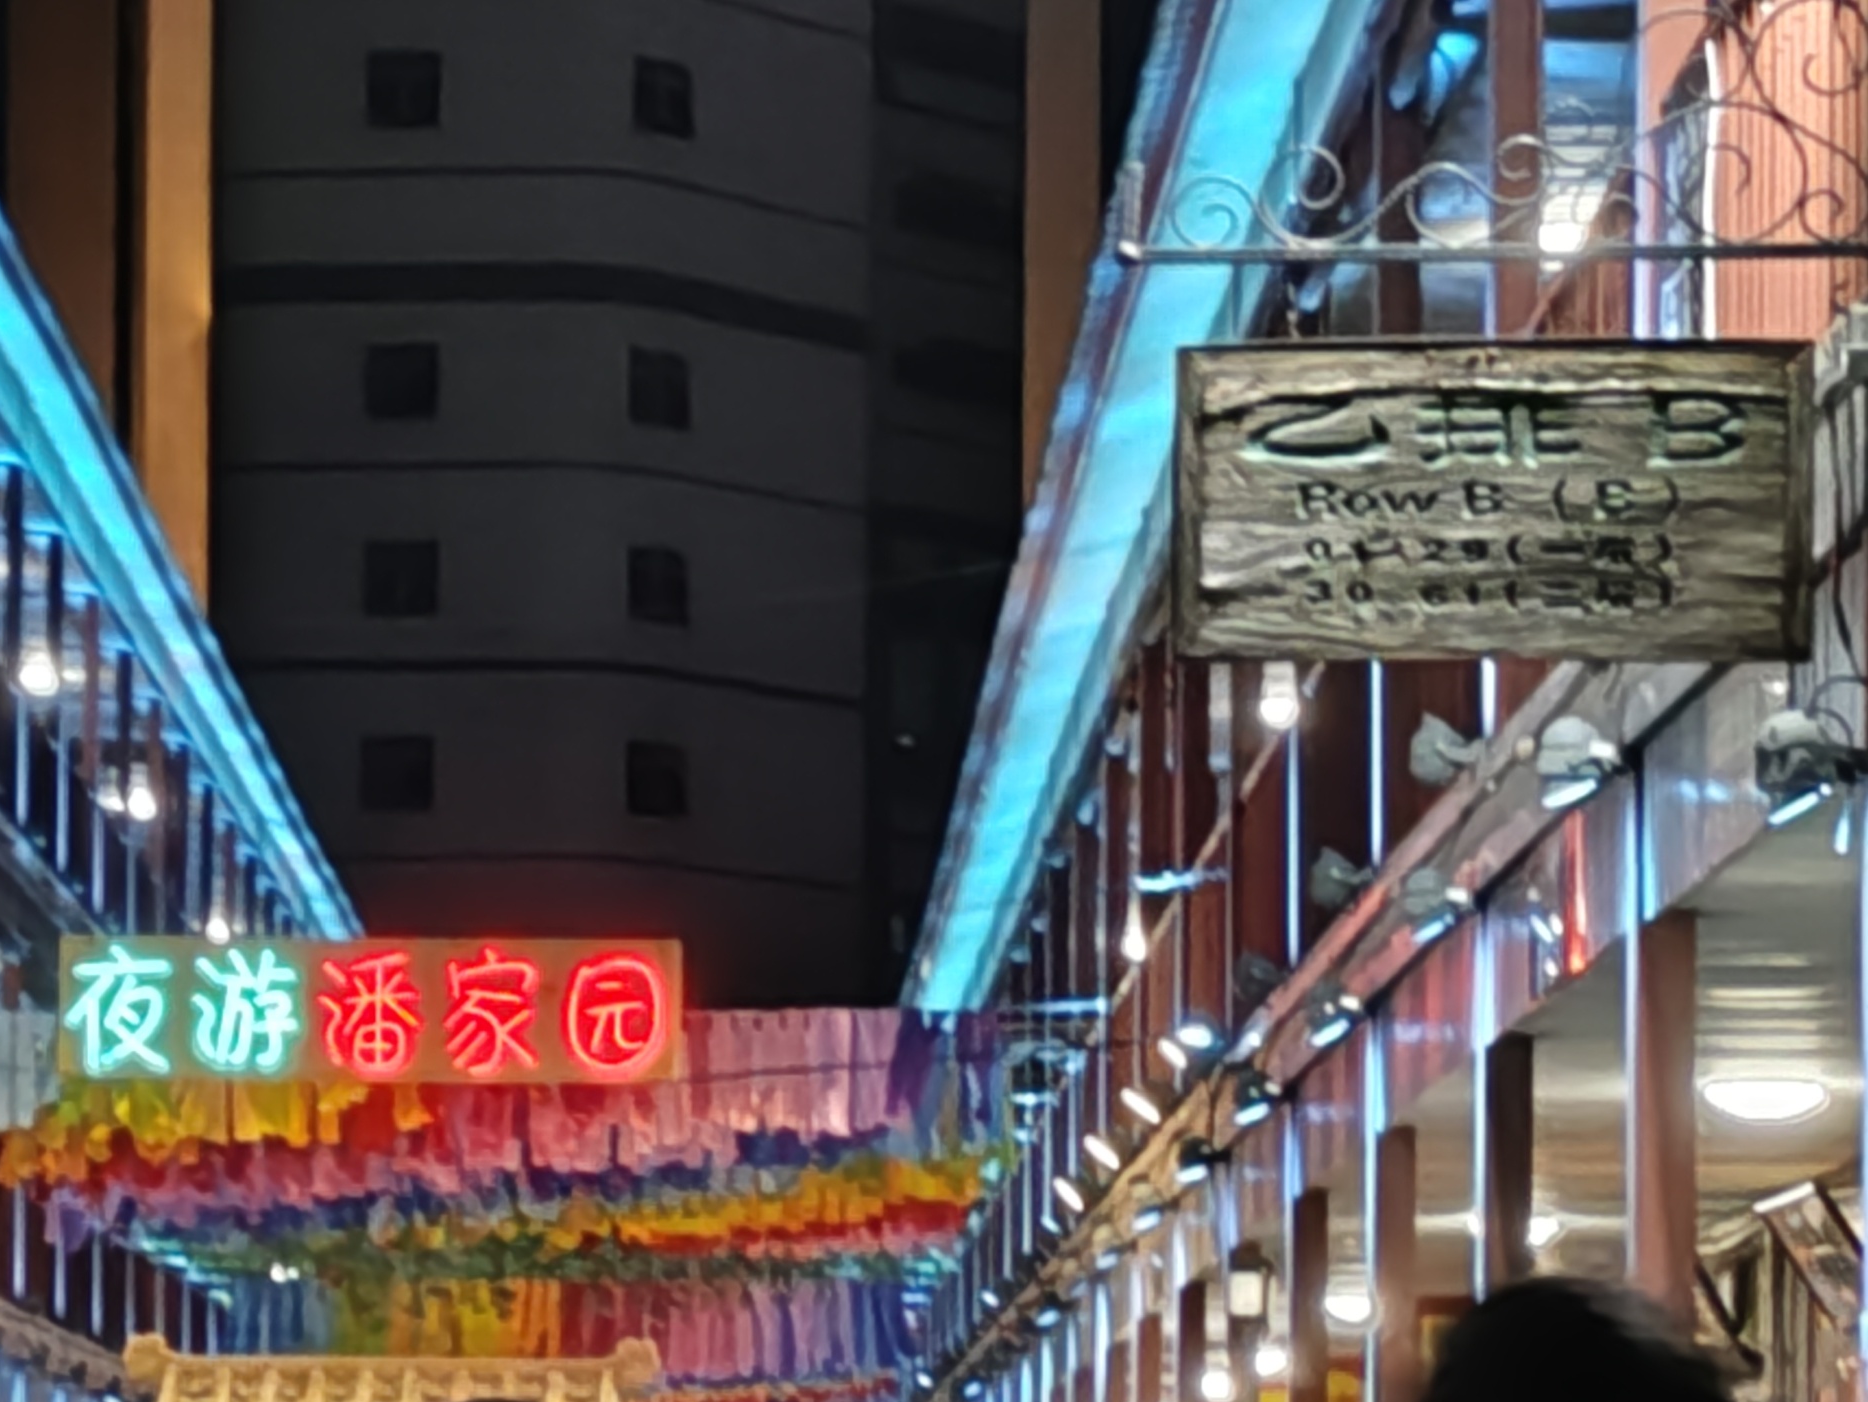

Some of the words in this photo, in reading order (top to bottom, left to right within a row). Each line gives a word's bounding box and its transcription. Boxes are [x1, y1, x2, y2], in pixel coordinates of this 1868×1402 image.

[1649, 396, 1747, 464] B
[1298, 481, 1439, 517] Row
[1463, 479, 1503, 515] B
[64, 944, 668, 1076] 夜游潘家园
